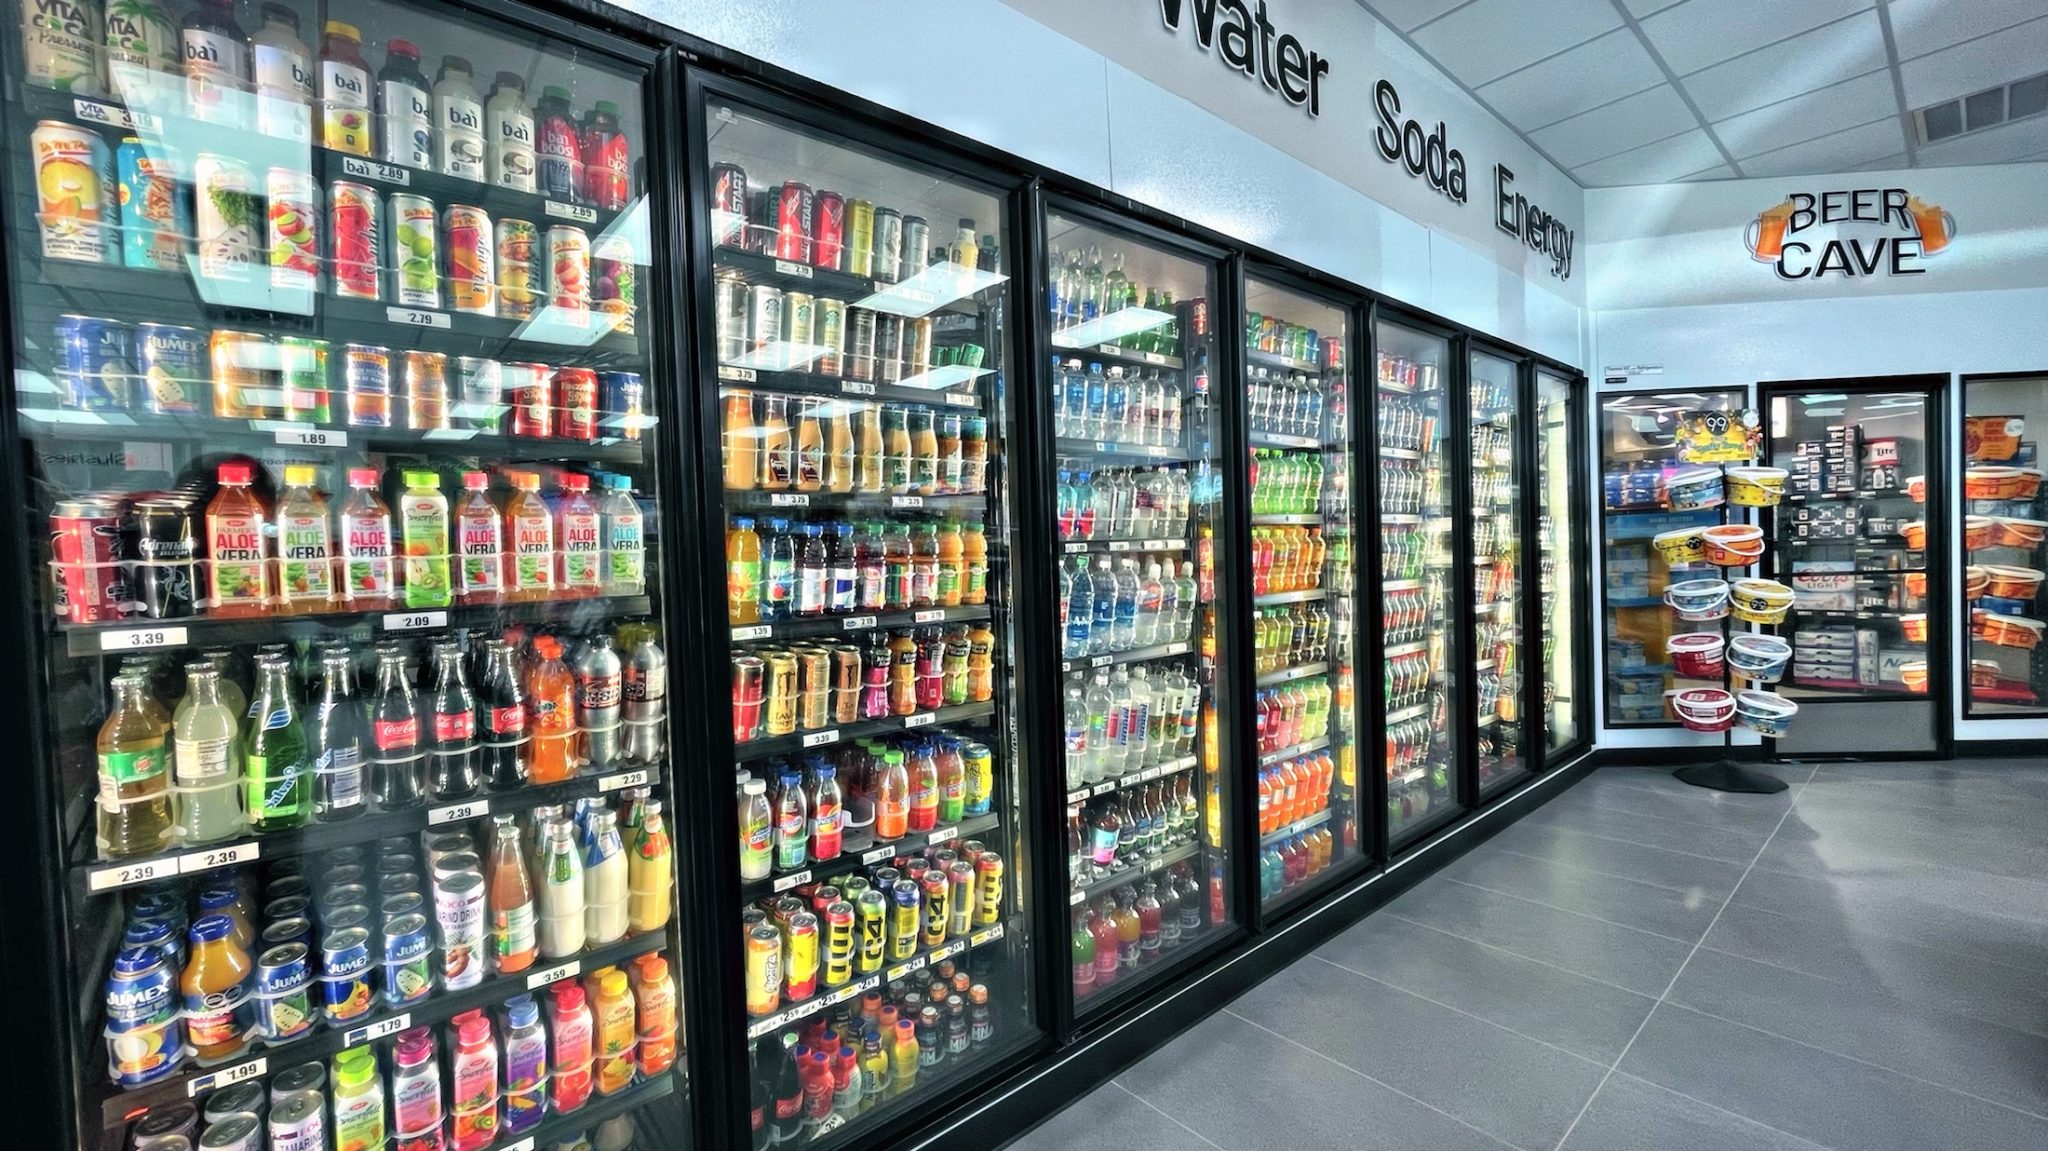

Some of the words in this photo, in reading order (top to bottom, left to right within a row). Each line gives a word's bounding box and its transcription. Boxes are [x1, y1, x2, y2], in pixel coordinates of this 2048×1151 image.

[186, 40, 218, 63] bai
[334, 71, 362, 94] bai
[412, 97, 431, 116] ba
[449, 107, 478, 129] bai
[502, 121, 529, 141] bai
[1373, 79, 1468, 203] Soda
[346, 160, 370, 176] bai
[1787, 188, 1913, 235] BEER
[1494, 162, 1575, 280] Energy
[1775, 236, 1926, 280] CAVE
[1706, 417, 1727, 432] 99
[300, 433, 327, 445] 1.89
[286, 532, 324, 546] ALOE
[350, 532, 386, 546] ALOE
[466, 530, 496, 543] ALOE
[520, 530, 549, 543] ALOE
[569, 529, 597, 541] ALOE
[612, 528, 639, 540] ALOE
[216, 534, 260, 549] ALOE
[216, 550, 261, 560] VERA
[286, 546, 326, 559] VERA
[349, 547, 387, 558] VERA
[464, 544, 497, 555] VERA
[404, 616, 430, 627] 2.09
[131, 633, 165, 645] 3.39
[623, 774, 642, 784] 2.29
[448, 808, 472, 819] 2.39
[206, 851, 238, 865] 2.39
[120, 866, 154, 883] 2.39
[544, 969, 566, 982] 3.59
[105, 984, 170, 1007] JUMEX
[378, 1019, 401, 1033] 1.79
[229, 1064, 257, 1080] 1.99
